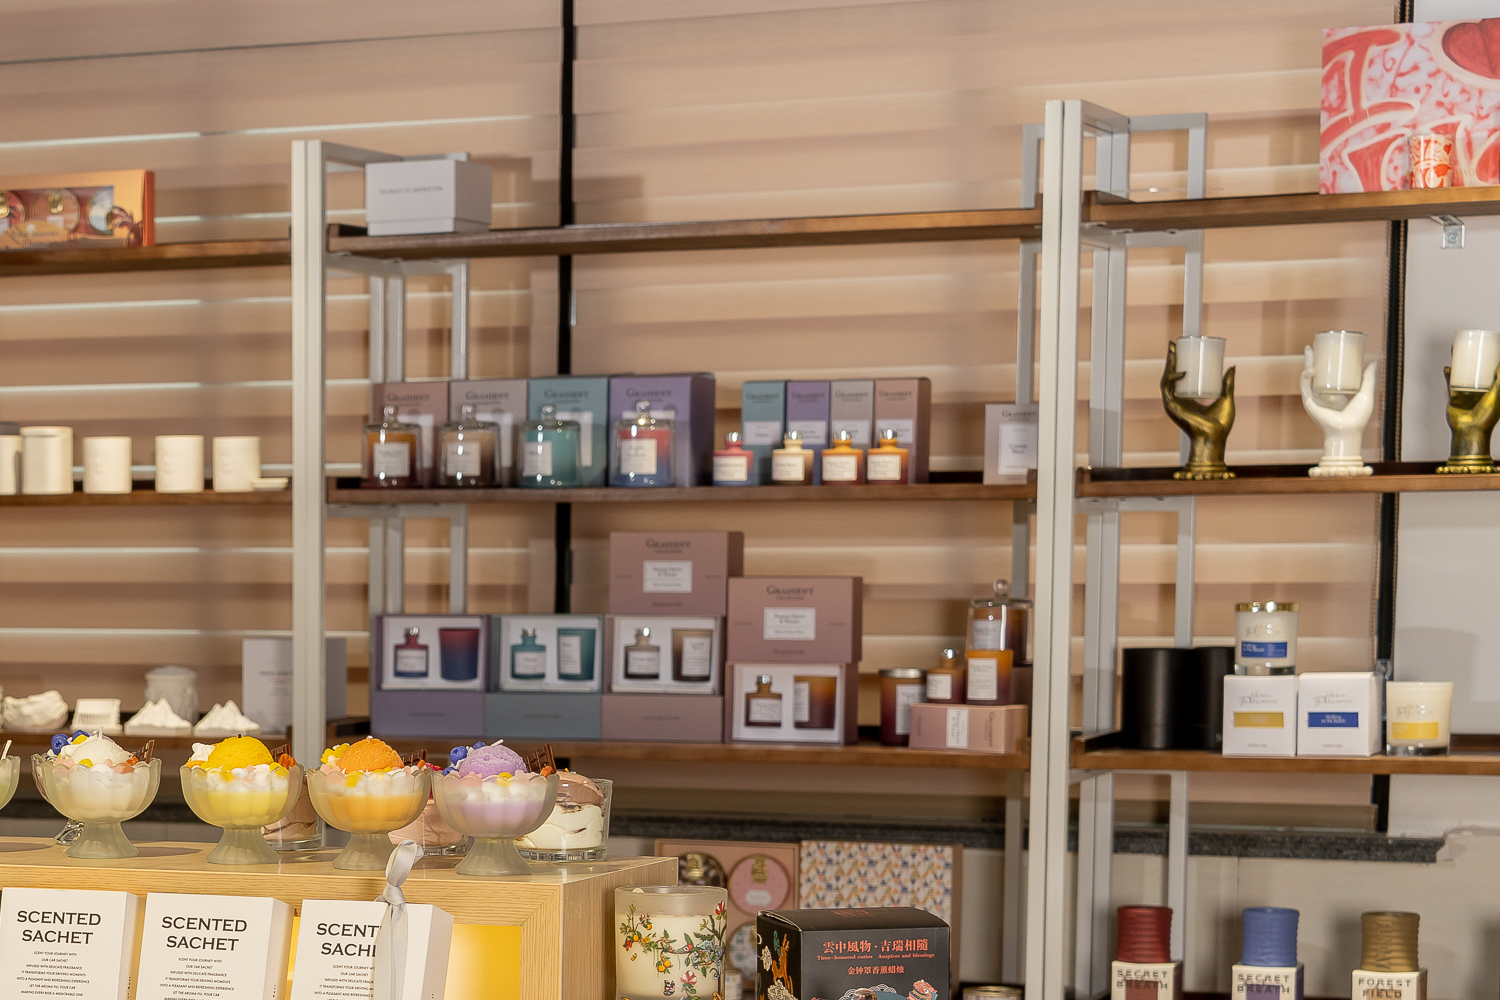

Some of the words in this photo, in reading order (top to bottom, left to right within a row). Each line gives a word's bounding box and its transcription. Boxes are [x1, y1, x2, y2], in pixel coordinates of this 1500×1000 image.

[17, 911, 101, 925] SCENTED
[162, 916, 247, 931] SCENTED
[317, 923, 382, 937] SCENT
[22, 930, 93, 944] SACHET
[167, 936, 239, 951] SACHET
[321, 943, 376, 957] SACH
[1117, 970, 1168, 979] SECRET
[1238, 974, 1289, 983] SECRET
[1117, 980, 1168, 990] BREATH
[1359, 978, 1411, 987] FOREST
[1237, 984, 1289, 994] BREATH
[1362, 989, 1402, 998] FIELD
